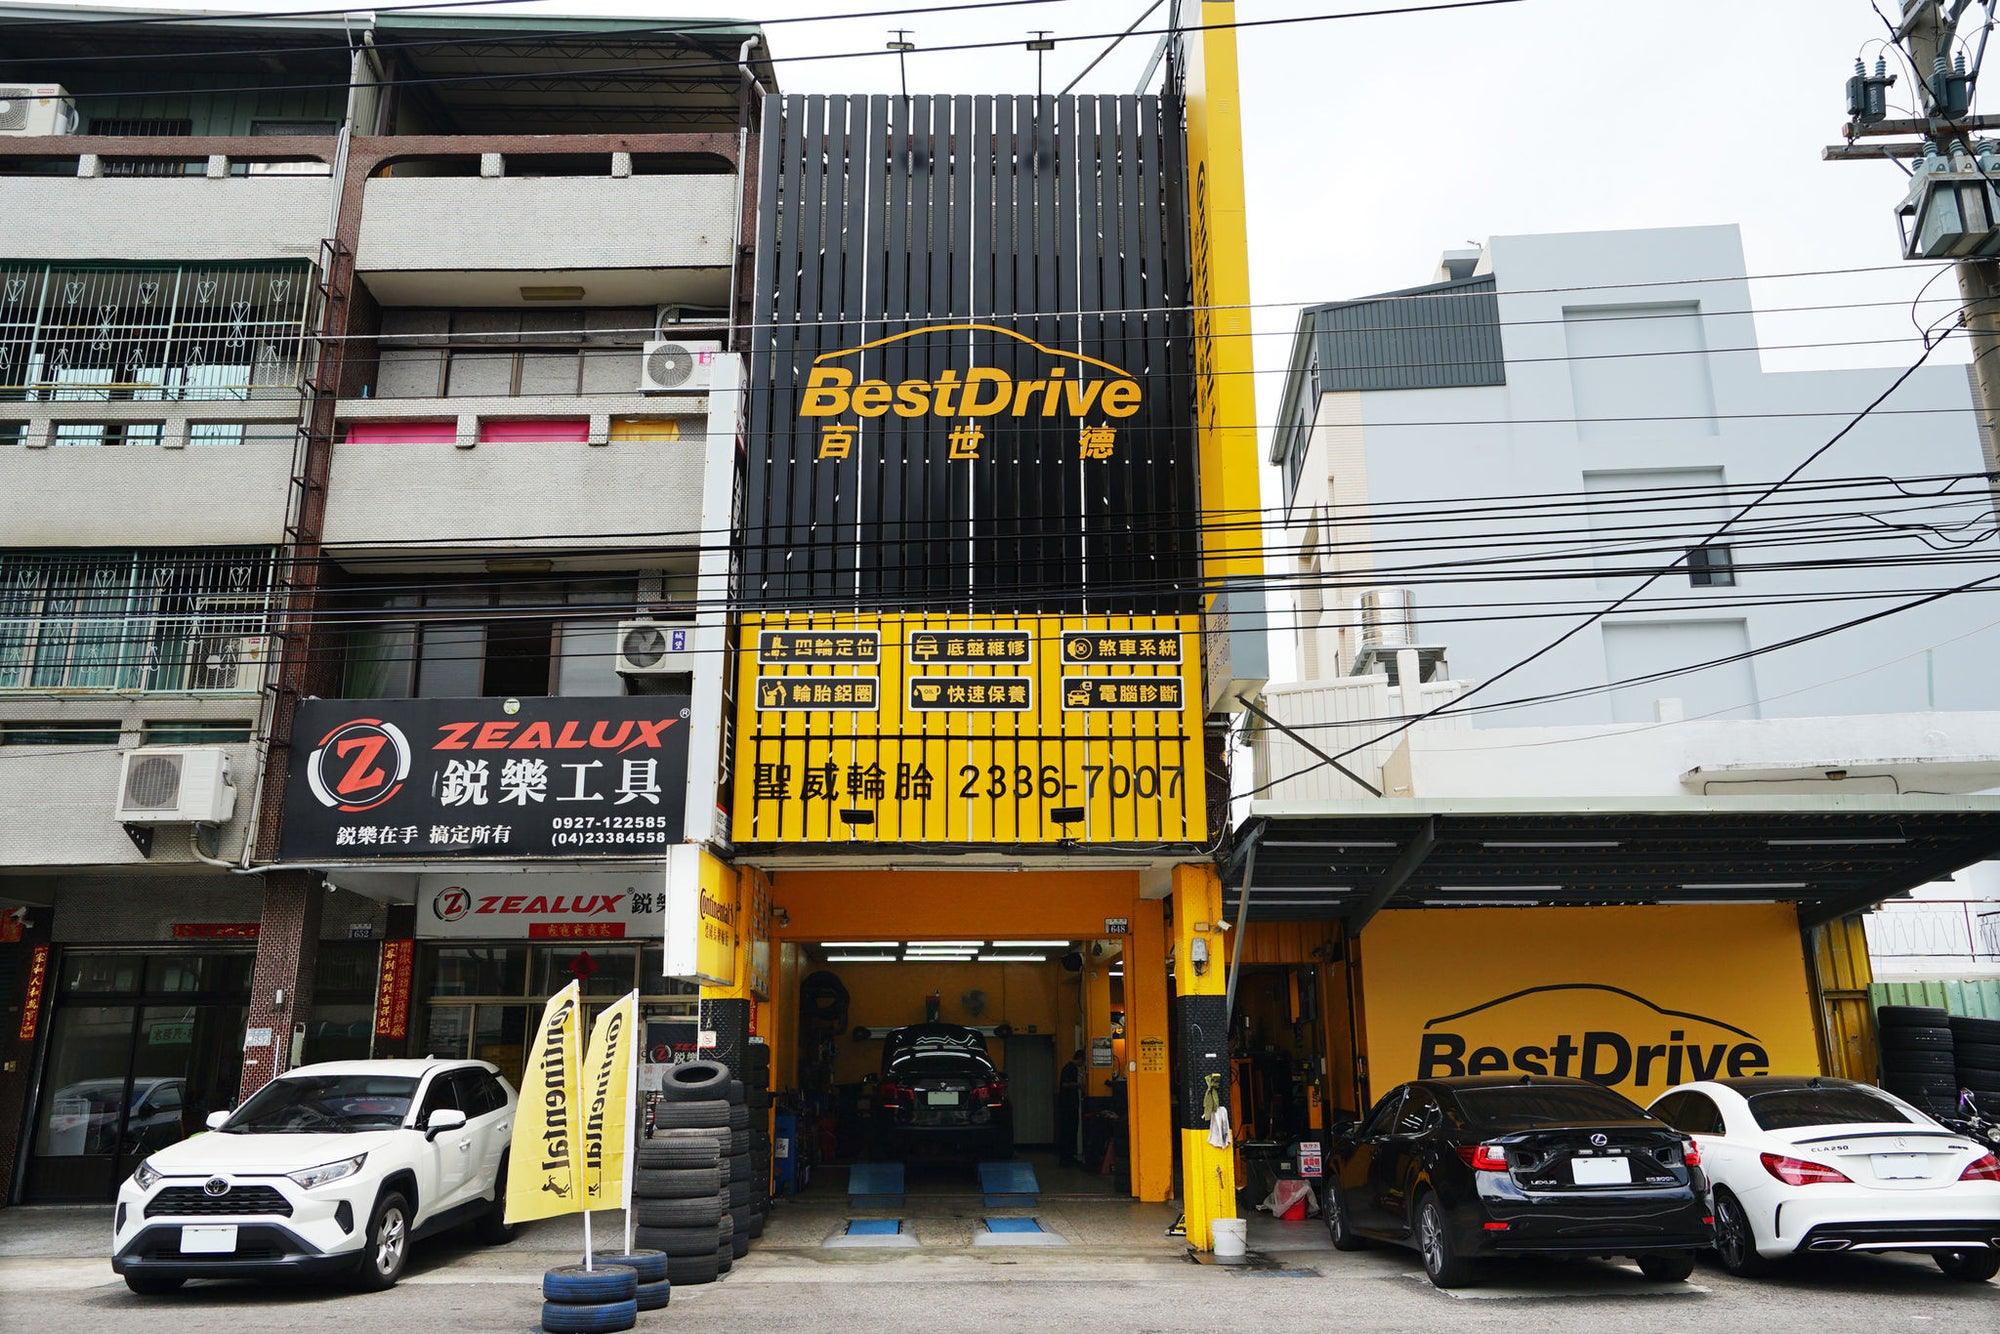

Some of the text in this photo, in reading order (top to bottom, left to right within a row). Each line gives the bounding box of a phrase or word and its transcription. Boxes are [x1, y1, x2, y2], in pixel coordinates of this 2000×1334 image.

[800, 367, 1142, 417] BestDrive
[818, 425, 1117, 459] 百世德
[795, 638, 874, 656] 四輪定位
[946, 638, 1025, 656] 底盤維修
[1098, 639, 1177, 657] 煞車系統
[792, 684, 872, 703] 輪胎鋁圈
[946, 685, 1026, 703] 快速保養
[1098, 684, 1178, 703] 電腦診斷
[432, 719, 678, 754] ZEALUX
[752, 762, 1185, 801] 聖威輪胎 2336-7007
[552, 816, 667, 829] 0927-122585
[429, 824, 511, 845] 搞定所有
[551, 831, 666, 845] (04)23384558
[474, 895, 626, 917] ZEALUX
[1417, 1030, 1769, 1087] BestDrive
